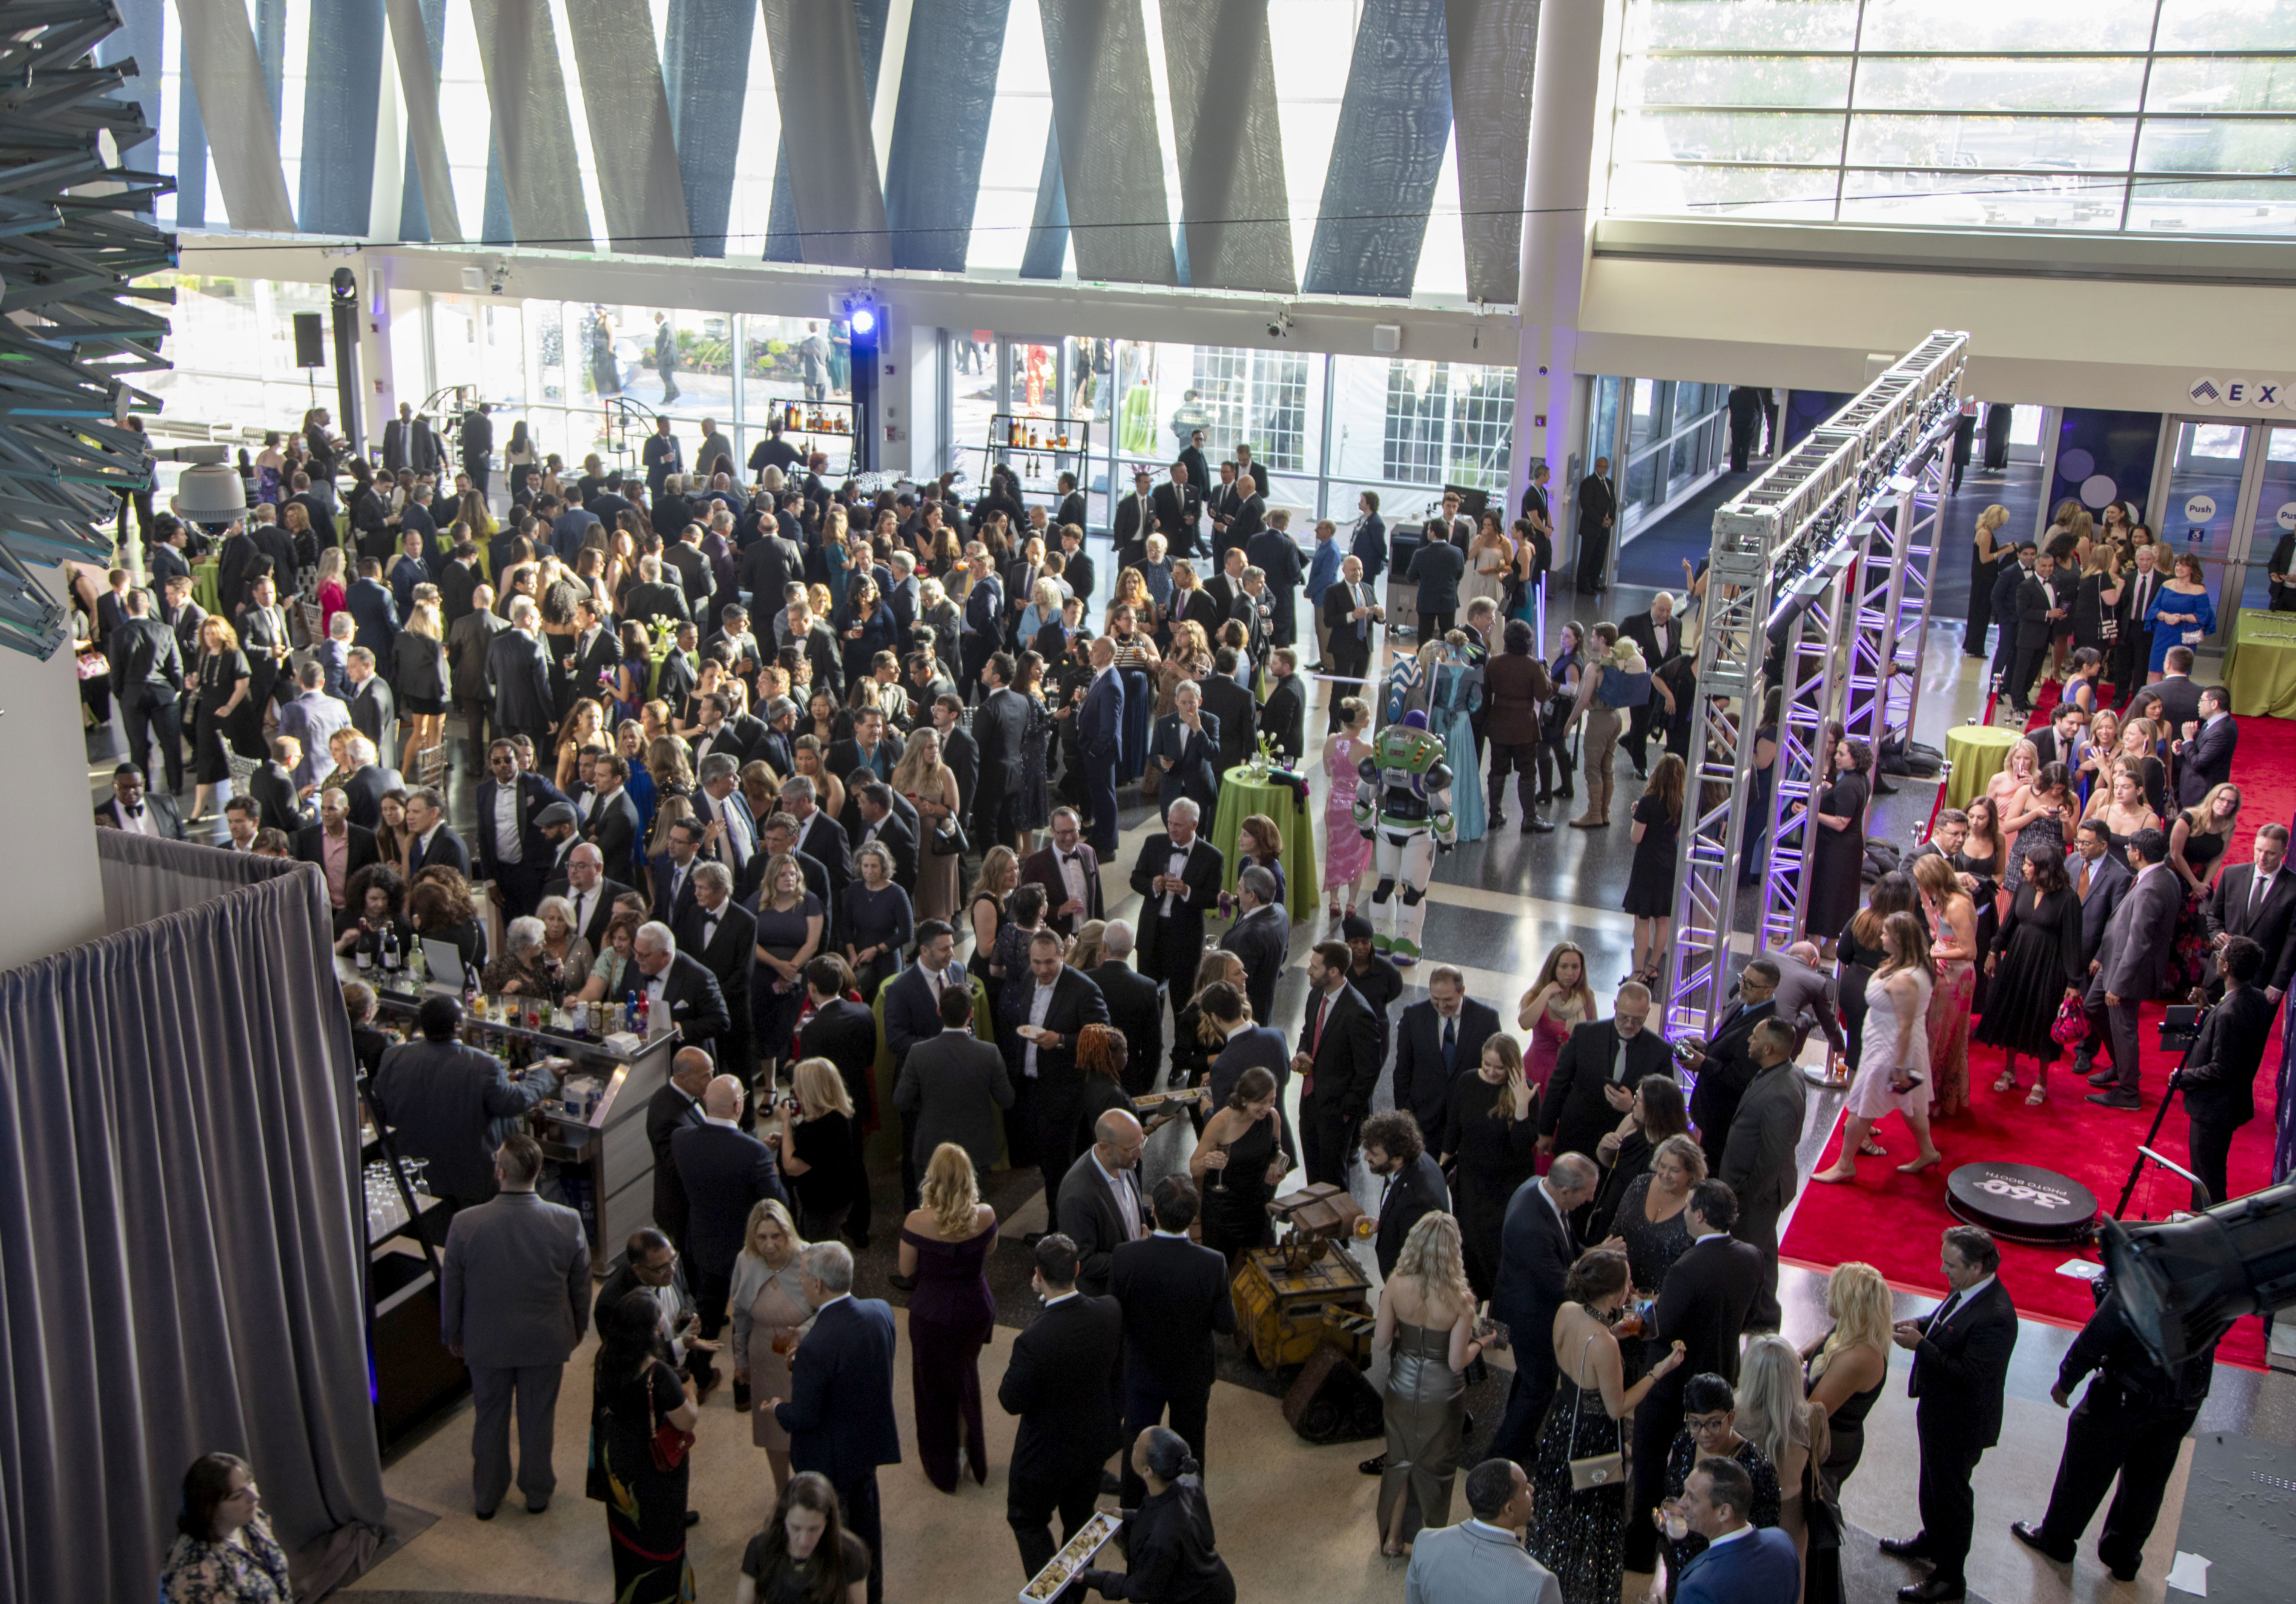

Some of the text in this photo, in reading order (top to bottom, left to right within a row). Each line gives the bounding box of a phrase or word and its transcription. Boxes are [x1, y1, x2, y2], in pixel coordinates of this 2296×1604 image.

[974, 329, 992, 343] EXIT
[2229, 384, 2278, 403] EX
[1961, 401, 1978, 415] XIT
[2189, 505, 2211, 513] Push
[1986, 1171, 2067, 1196] PHOTO BOOTH
[1972, 1179, 2071, 1209] 360
